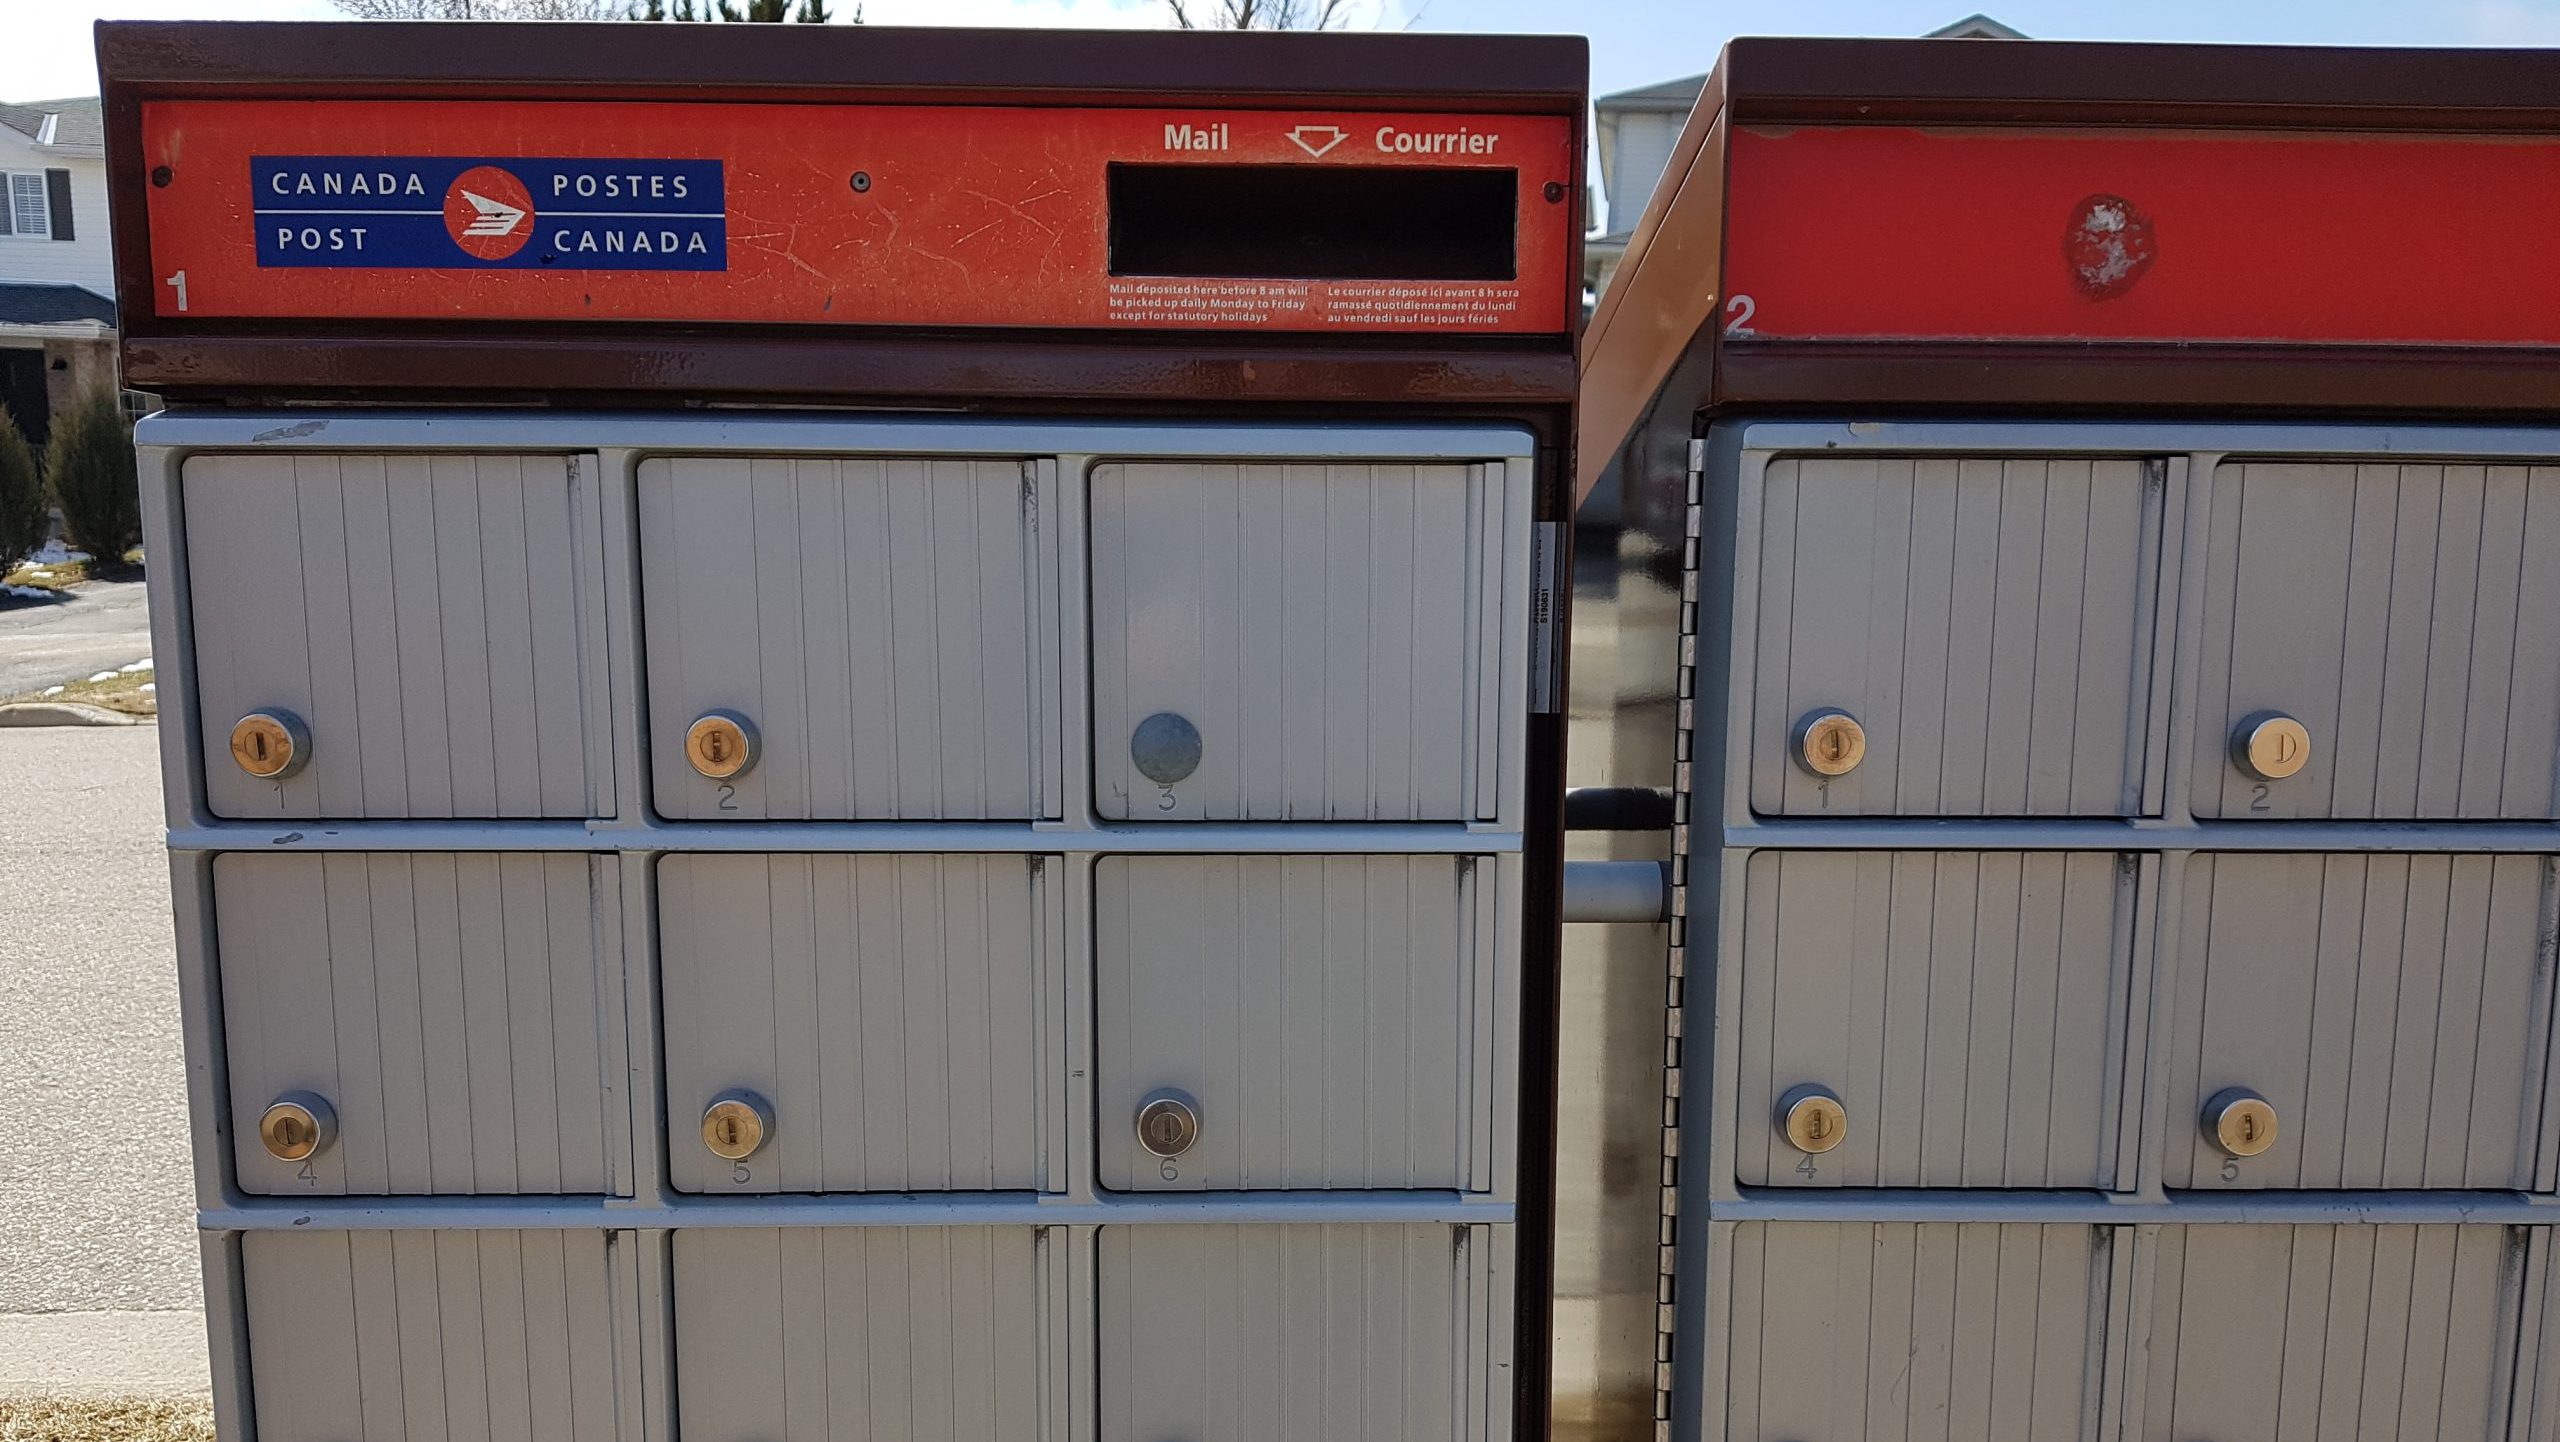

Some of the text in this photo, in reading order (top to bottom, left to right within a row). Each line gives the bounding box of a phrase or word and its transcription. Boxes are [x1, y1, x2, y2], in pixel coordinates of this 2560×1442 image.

[1164, 123, 1229, 151] Mail
[1375, 126, 1499, 155] Courrier
[272, 172, 426, 196] CANADA
[554, 174, 689, 199] POSTES
[279, 228, 367, 251] POST
[554, 230, 708, 255] CANADA
[167, 270, 188, 311] 1
[1110, 284, 1309, 298] Mail deposited here before 8 am will
[1328, 287, 1520, 299] Le courrier déposé ici avant 8 h sera
[1110, 297, 1306, 311] be picked up daily Monday to Friday
[1110, 310, 1268, 323] except for statutory holidays
[1328, 300, 1517, 312] ramassé quotidiennement du lundi
[1727, 295, 1756, 335] 2
[1328, 313, 1499, 325] au vendredi sauf les jours fériés
[273, 782, 285, 809] 1
[717, 785, 738, 811] 2
[1158, 784, 1177, 811] 3
[1817, 779, 1829, 808] 1
[2250, 785, 2270, 812] 2
[297, 1159, 318, 1186] 4
[732, 1160, 752, 1185] 5
[1159, 1158, 1179, 1182] 6
[1795, 1153, 1818, 1180] 4
[2220, 1157, 2240, 1182] 5
